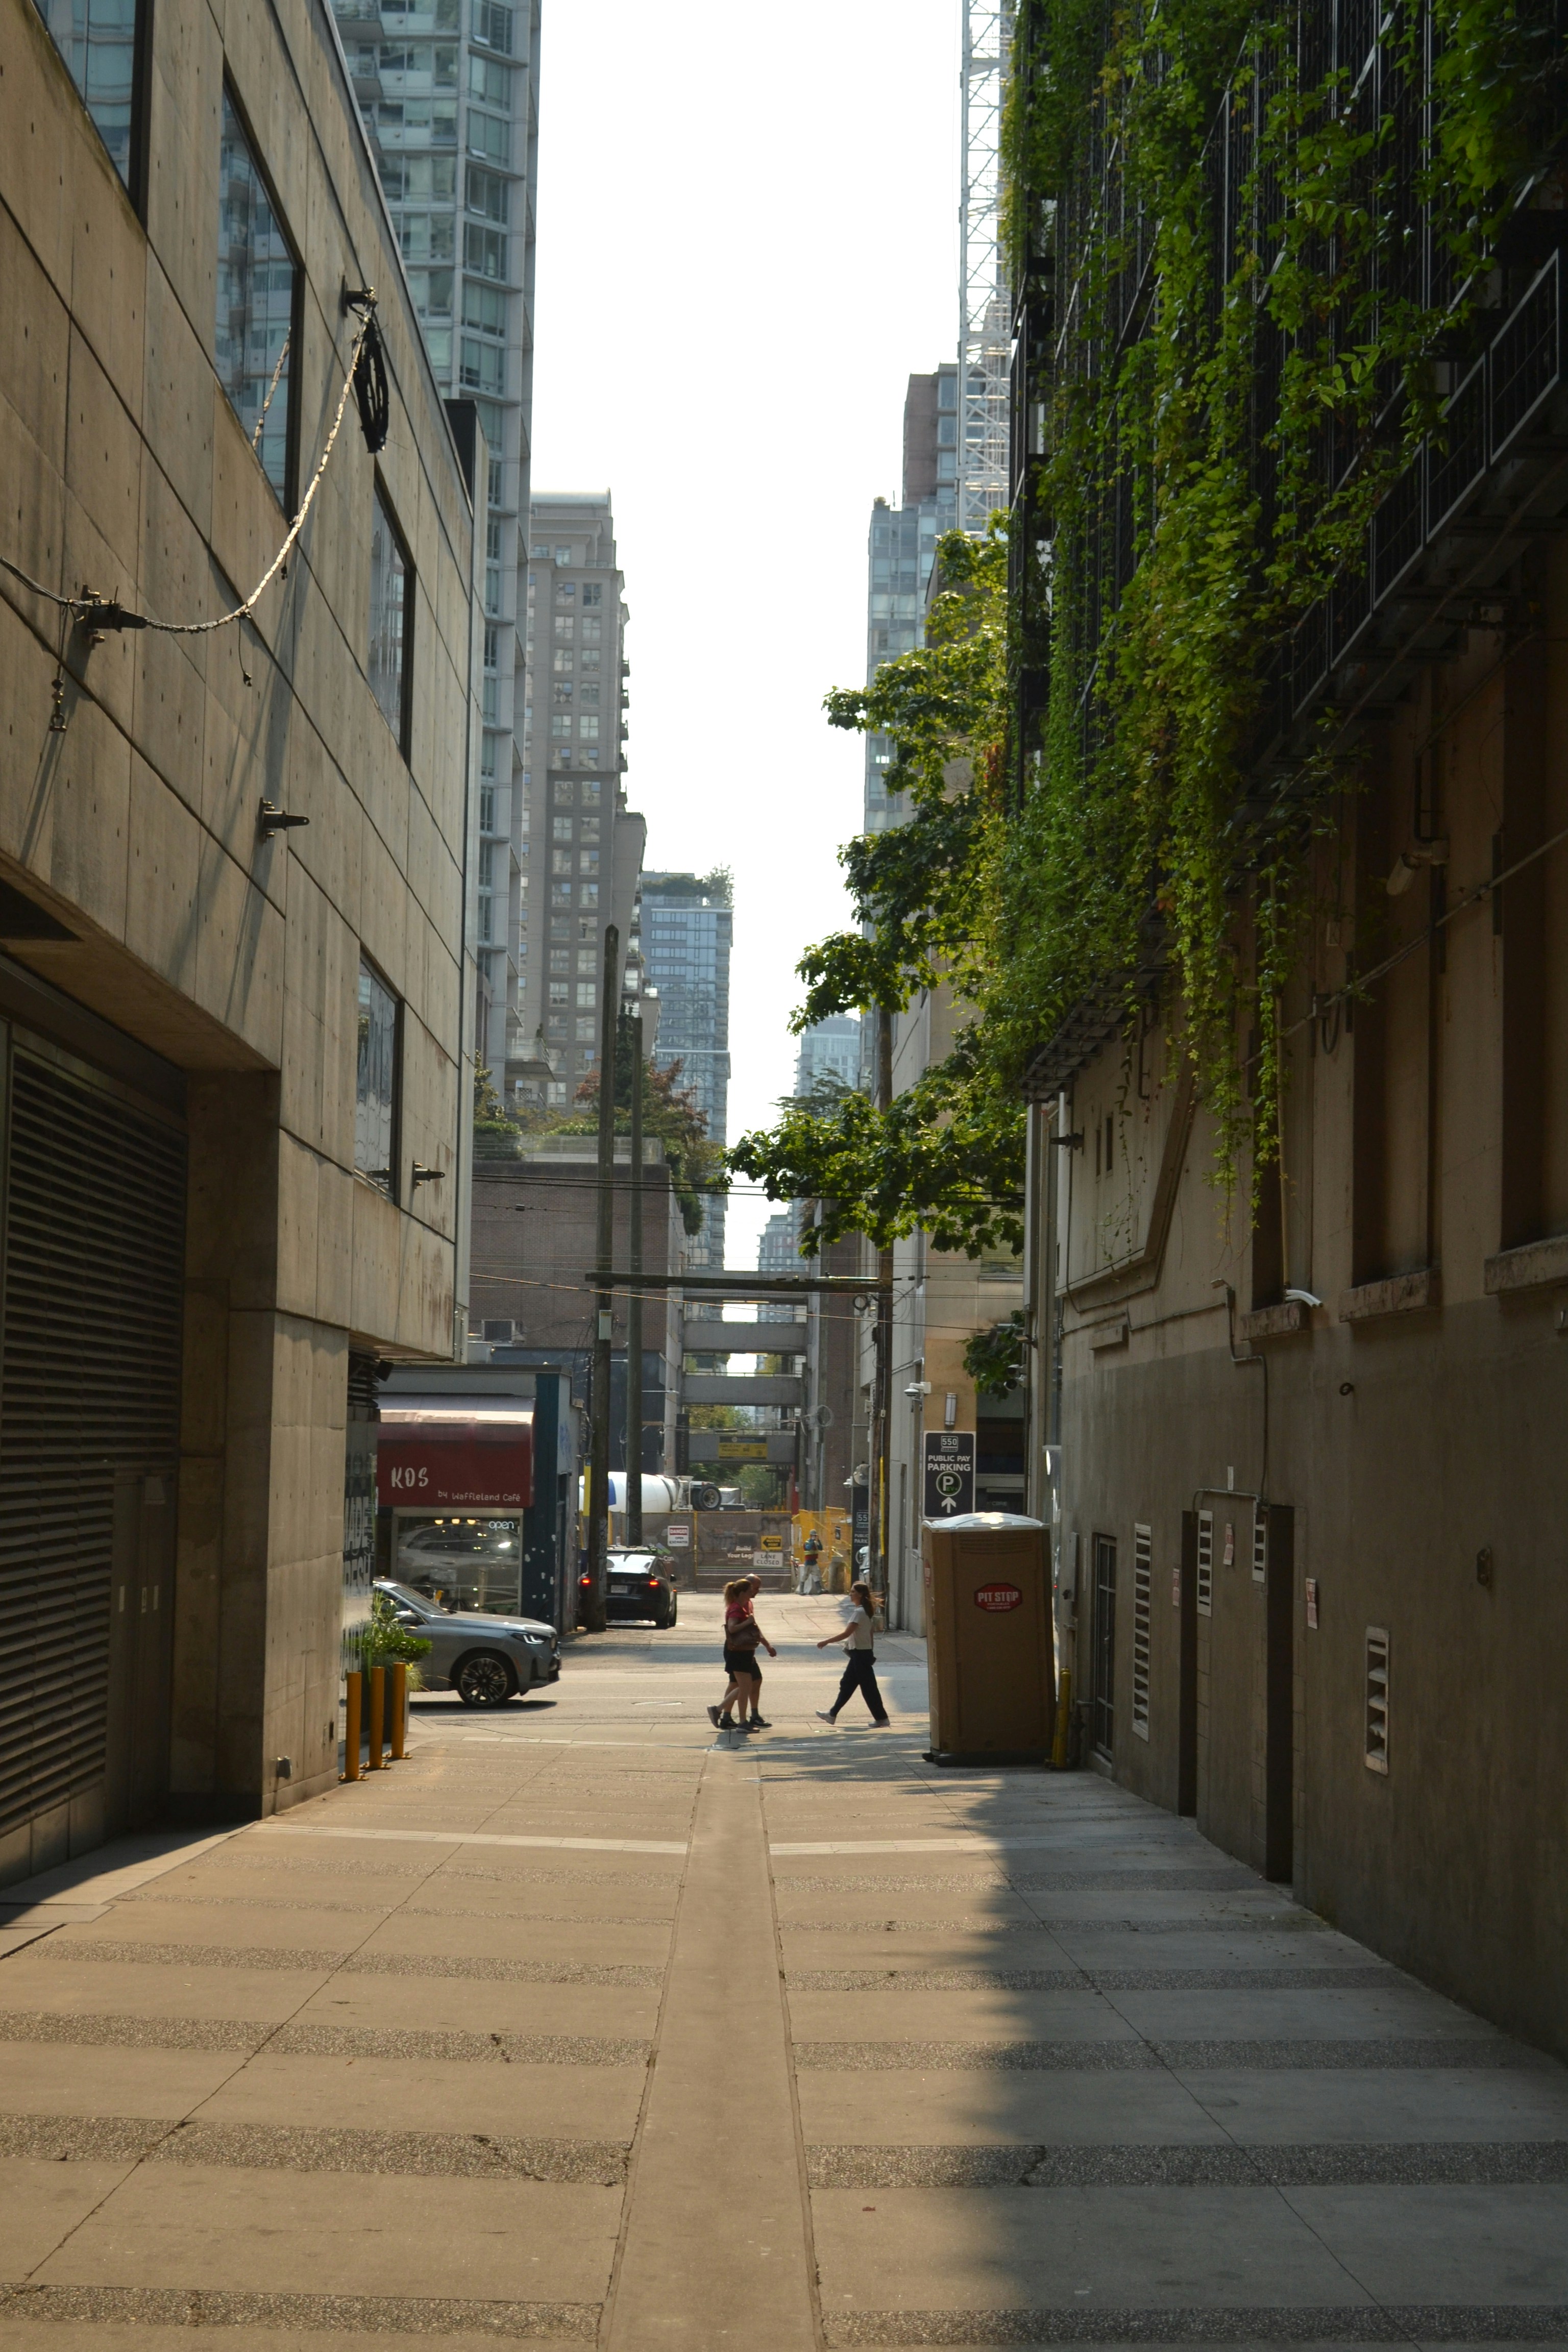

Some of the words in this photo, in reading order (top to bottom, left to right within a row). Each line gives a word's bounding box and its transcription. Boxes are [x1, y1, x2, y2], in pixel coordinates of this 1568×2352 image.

[927, 1463, 971, 1472] PARKING
[391, 1467, 429, 1488] KOS
[942, 1476, 954, 1491] P
[437, 1490, 448, 1499] by
[452, 1492, 500, 1501] Waffleland
[503, 1493, 521, 1502] Café
[488, 1521, 514, 1530] open
[978, 1592, 993, 1602] PIT
[994, 1591, 1018, 1602] STOP
